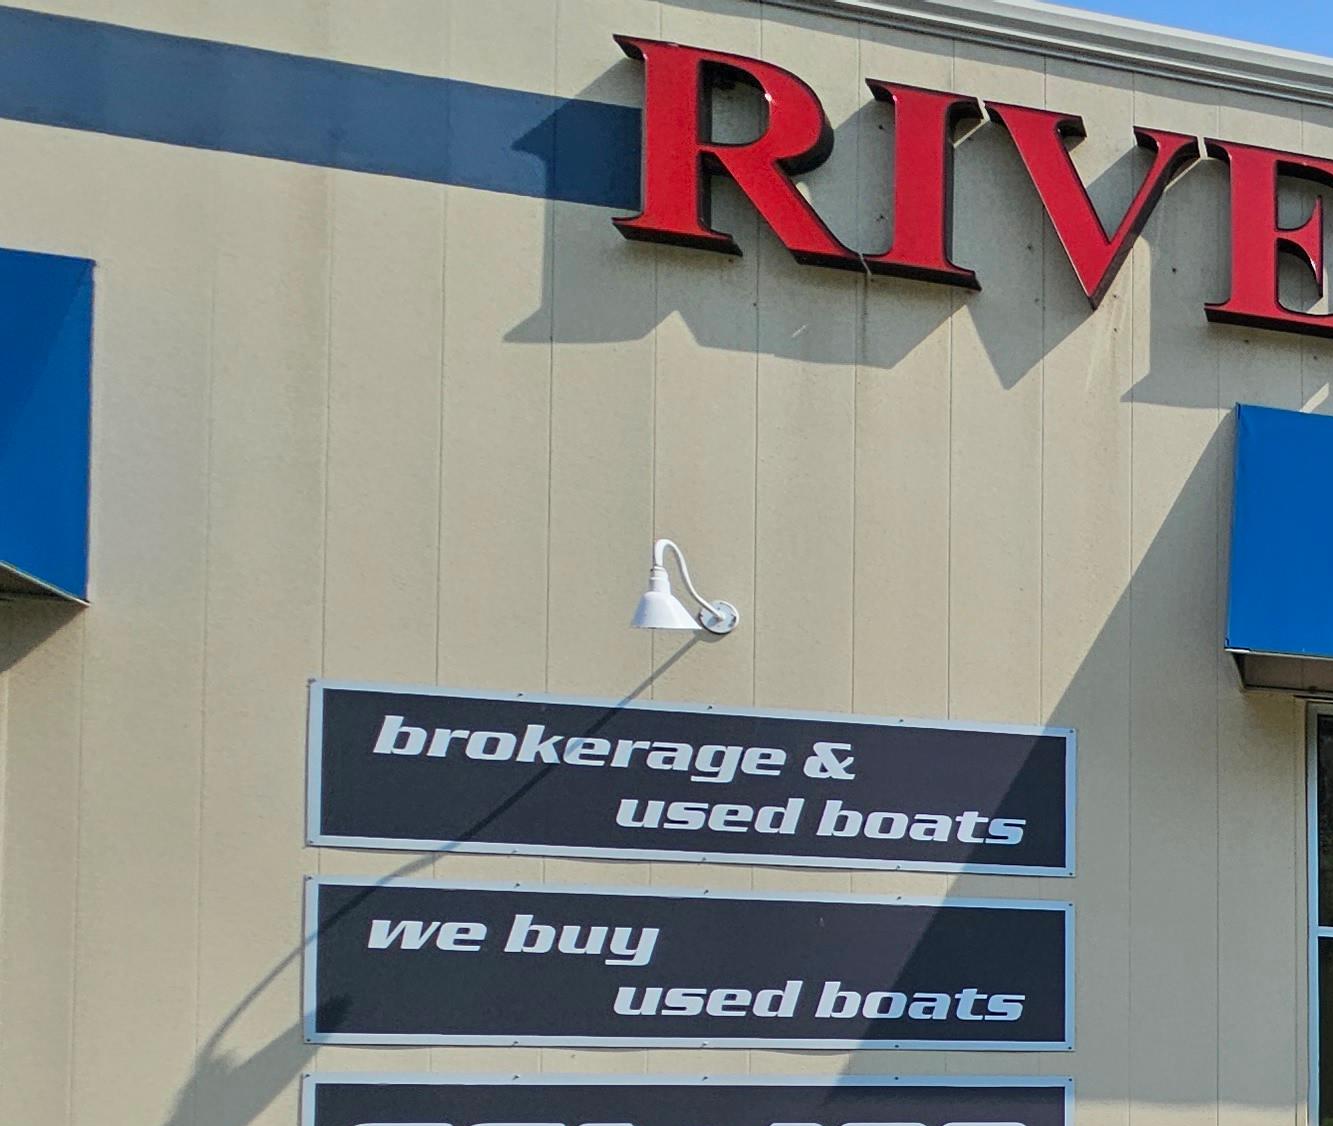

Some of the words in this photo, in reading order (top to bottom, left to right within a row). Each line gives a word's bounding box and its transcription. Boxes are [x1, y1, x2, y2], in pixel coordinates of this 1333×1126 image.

[373, 714, 786, 783] brokerage
[803, 741, 856, 780] &
[615, 797, 801, 836] used
[816, 800, 1027, 845] boats
[367, 918, 487, 951] we
[504, 914, 660, 966] buy
[613, 980, 803, 1020] used
[814, 981, 1026, 1021] boats
